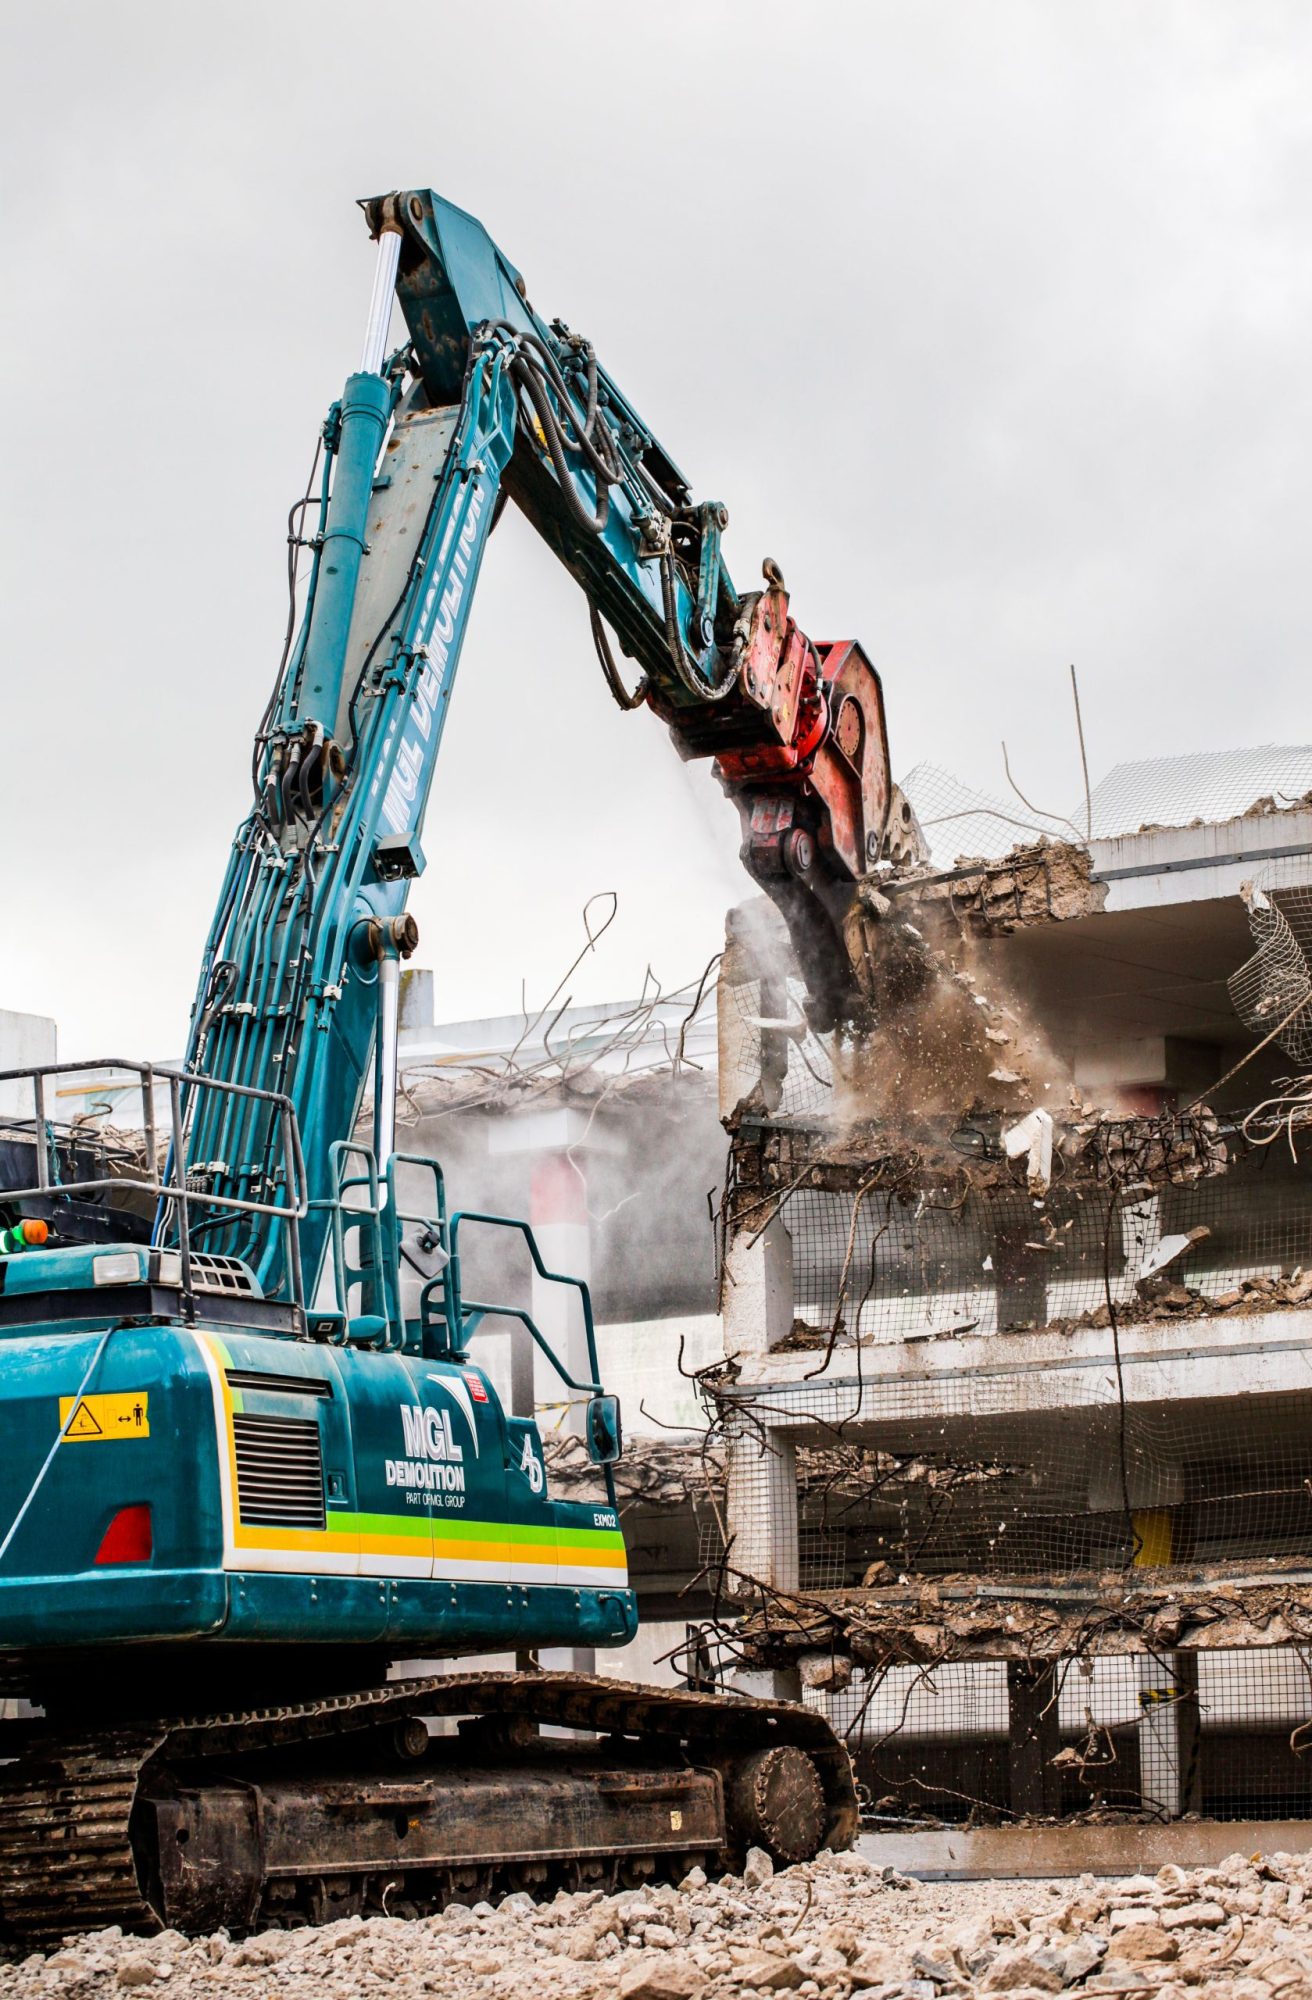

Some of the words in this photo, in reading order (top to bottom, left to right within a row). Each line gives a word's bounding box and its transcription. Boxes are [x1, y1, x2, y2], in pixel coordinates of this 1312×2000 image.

[371, 718, 424, 834] MGL
[400, 1404, 463, 1462] MGL
[385, 1459, 466, 1492] DEMOLITION
[406, 1492, 421, 1505] PART
[445, 1496, 466, 1509] GROUP
